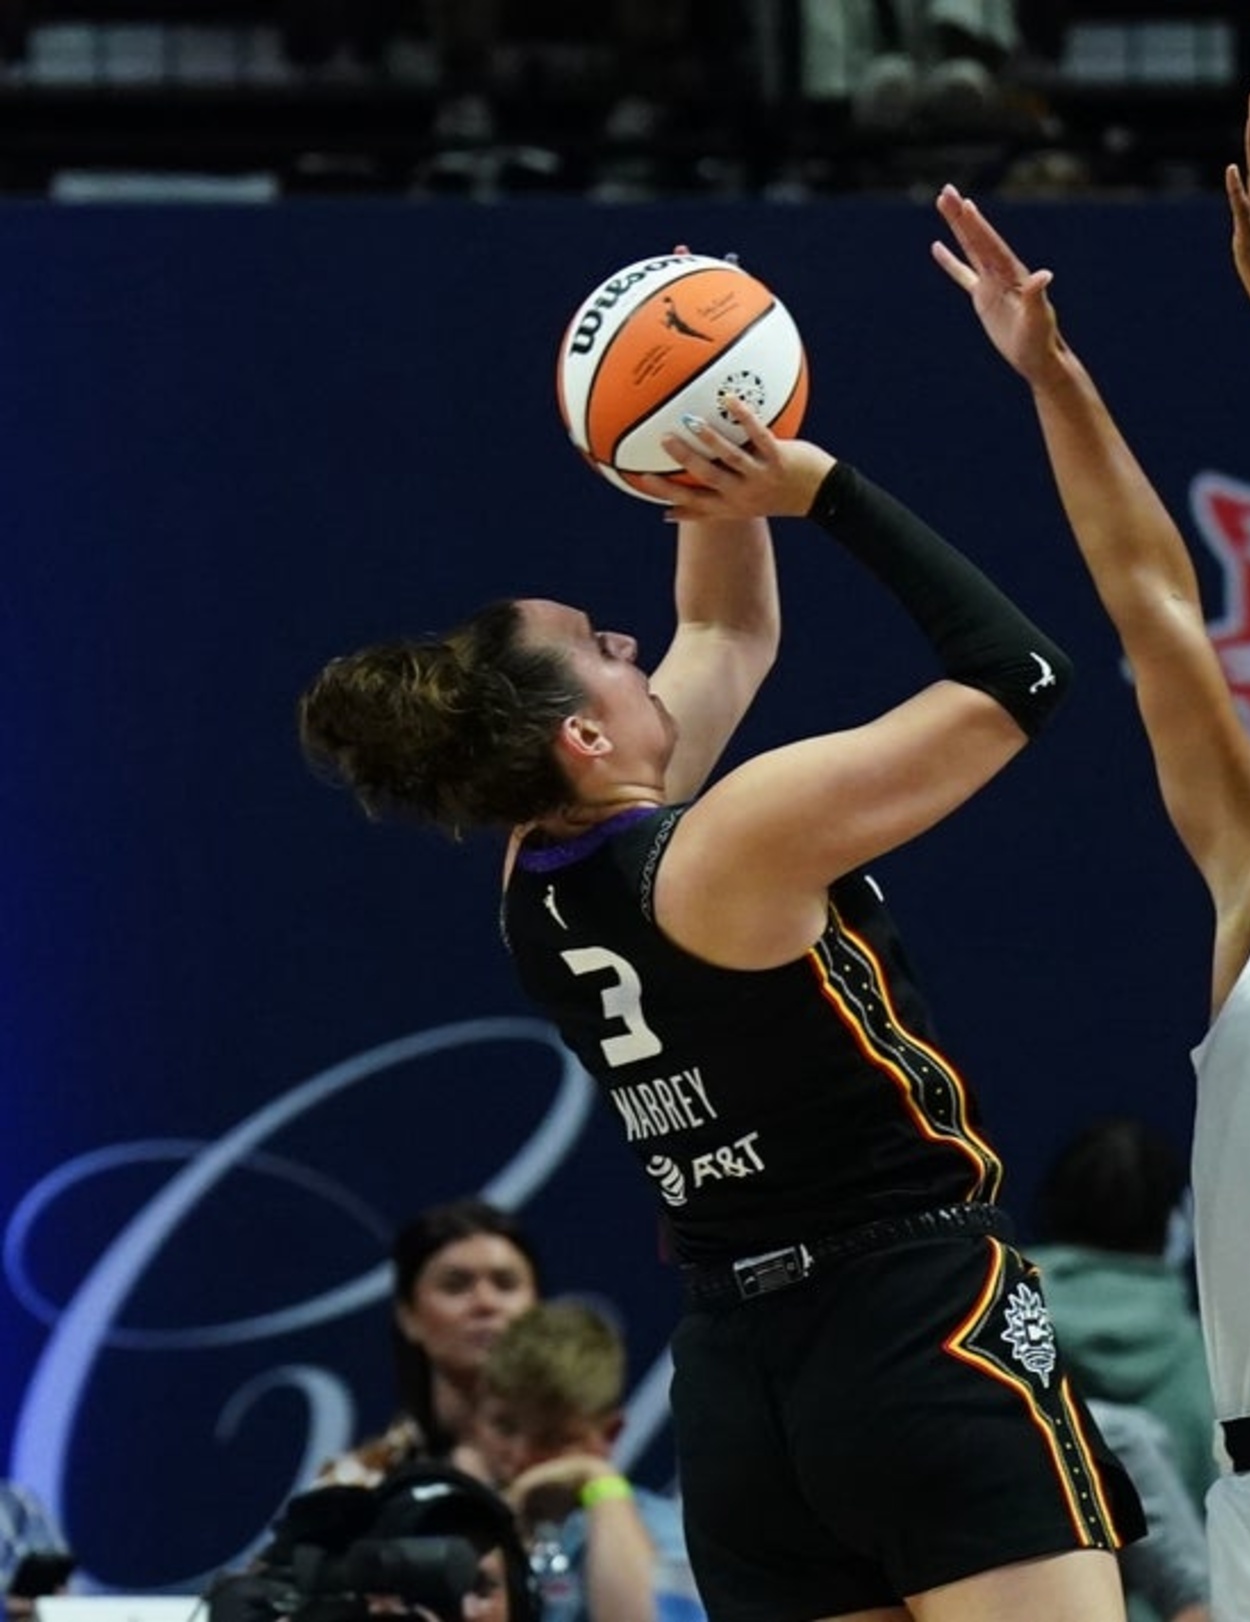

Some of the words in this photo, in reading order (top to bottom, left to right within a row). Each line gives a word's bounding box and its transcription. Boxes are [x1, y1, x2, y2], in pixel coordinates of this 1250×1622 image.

[560, 946, 663, 1068] 3
[611, 1066, 718, 1142] MABREY
[691, 1131, 766, 1188] A&T
